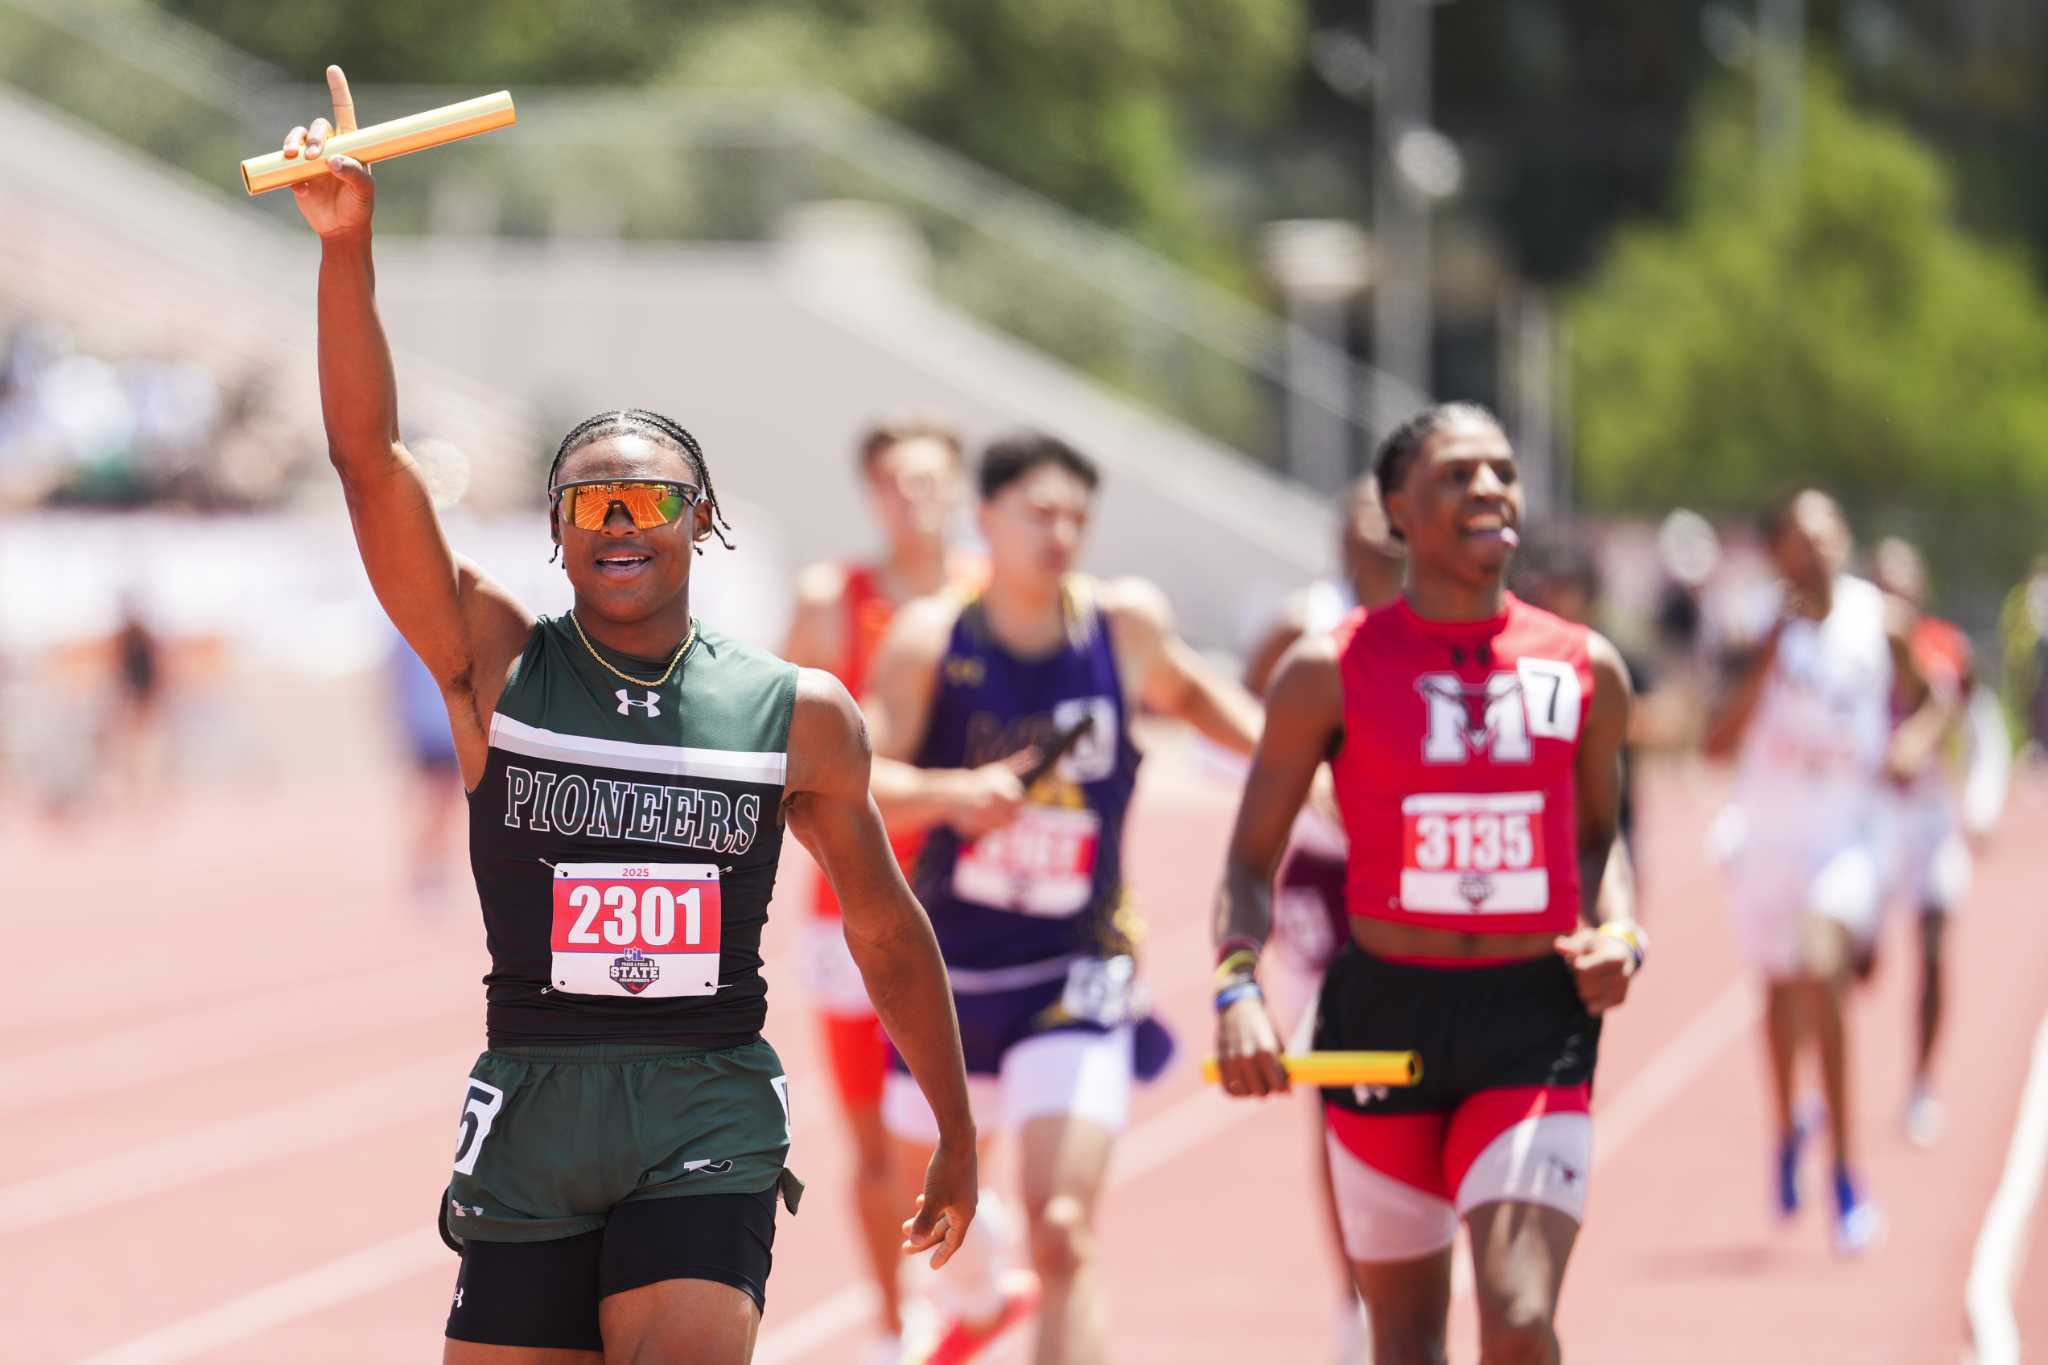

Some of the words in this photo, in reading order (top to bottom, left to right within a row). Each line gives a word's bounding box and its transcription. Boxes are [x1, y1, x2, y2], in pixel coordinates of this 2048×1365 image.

[1413, 670, 1535, 765] M
[1530, 671, 1561, 724] 7
[504, 766, 760, 855] PIONEERS
[1415, 814, 1533, 870] 3135
[622, 868, 650, 877] 2025
[567, 885, 701, 946] 2301
[610, 966, 659, 979] STATE
[454, 1085, 496, 1164] 5
